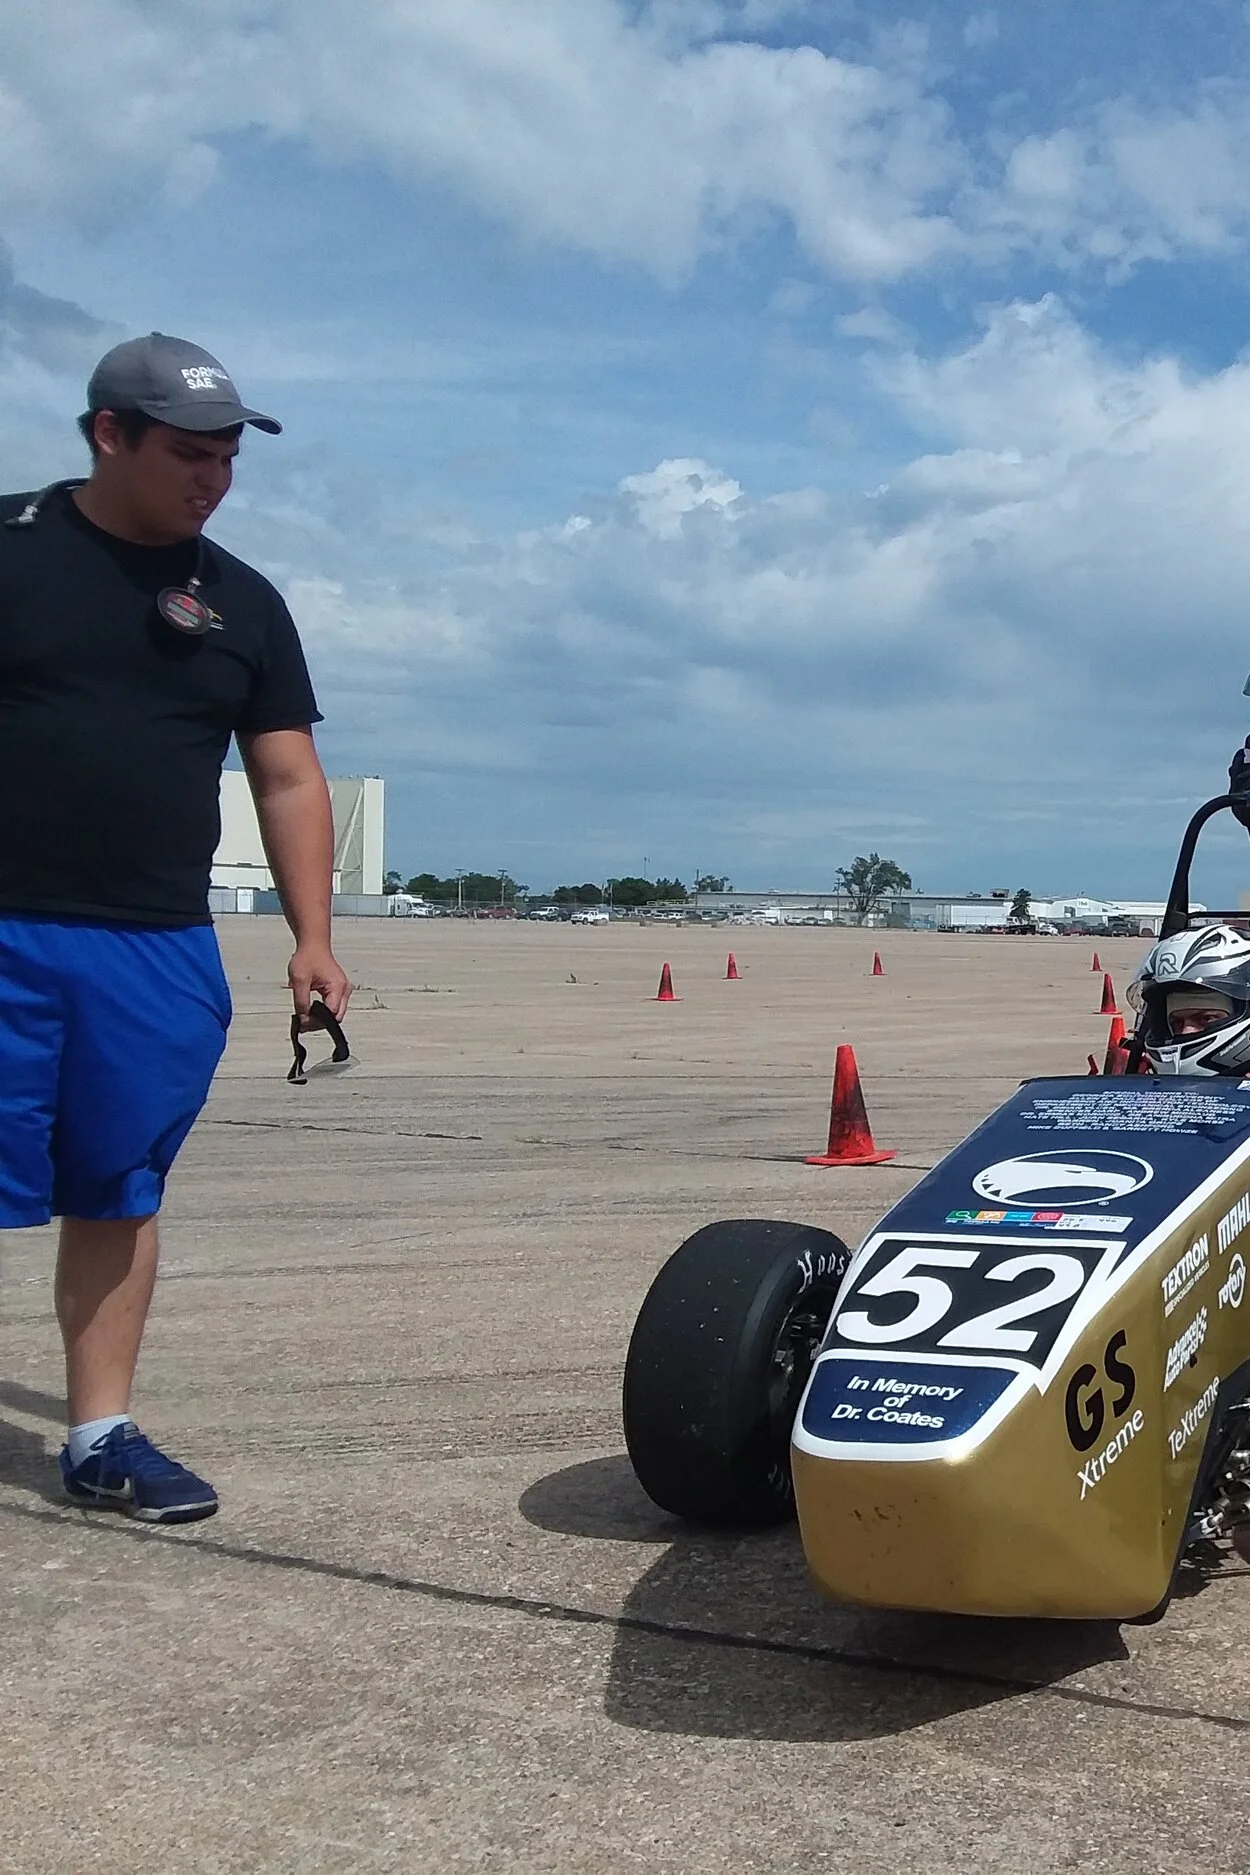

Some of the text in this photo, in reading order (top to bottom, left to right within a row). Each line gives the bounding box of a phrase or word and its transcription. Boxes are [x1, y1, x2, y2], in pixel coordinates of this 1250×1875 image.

[836, 1247, 1085, 1352] 52
[1161, 1233, 1210, 1302] TEXTRON
[1217, 1265, 1247, 1310] rotary
[831, 1403, 945, 1428] Dr. Coates
[847, 1376, 964, 1401] In Memory
[883, 1394, 913, 1408] of
[1065, 1329, 1136, 1452] GS
[1168, 1376, 1220, 1461] TeXtreme
[1077, 1409, 1145, 1501] Xtreme
